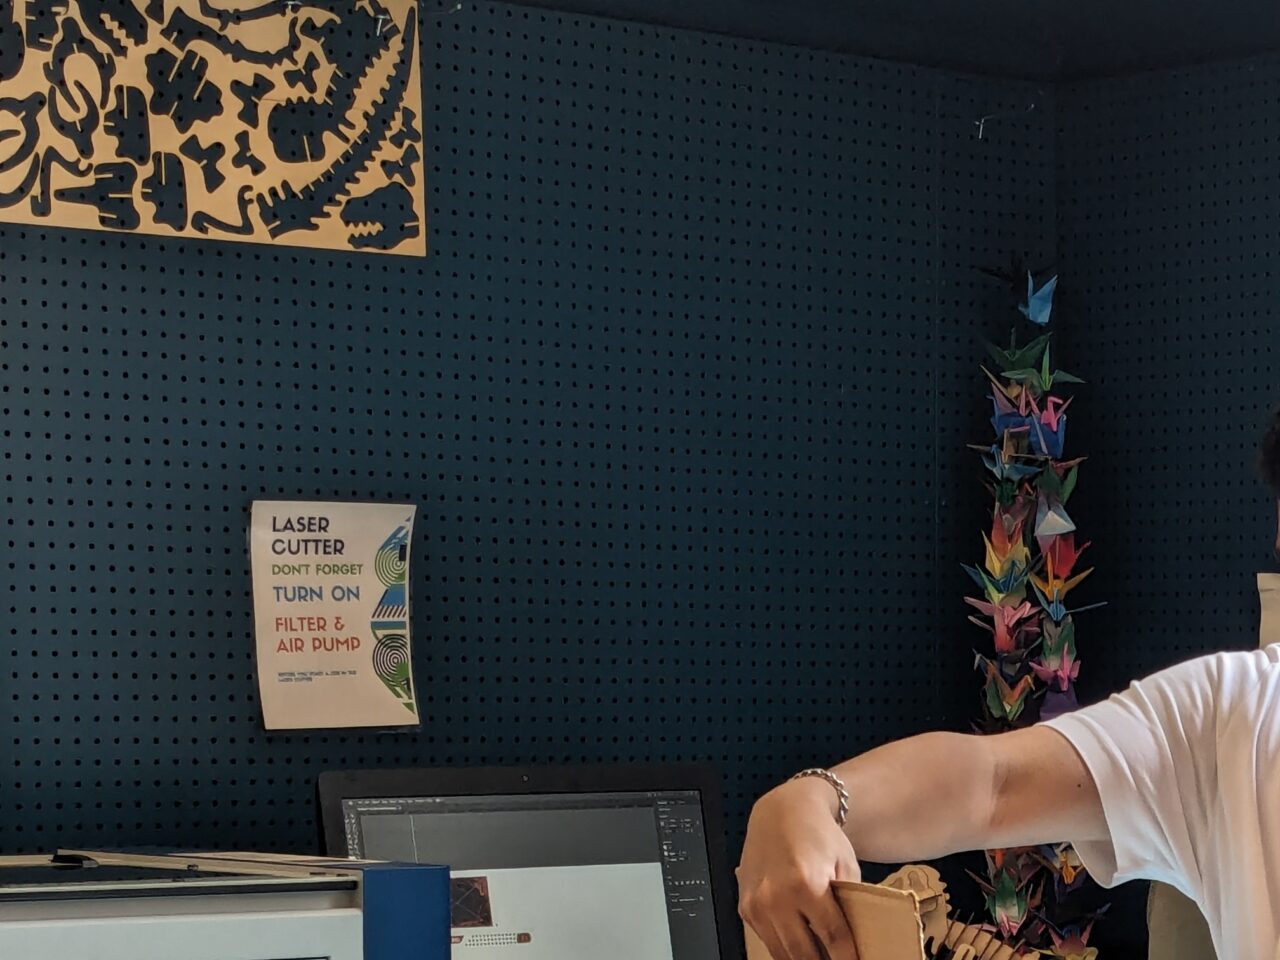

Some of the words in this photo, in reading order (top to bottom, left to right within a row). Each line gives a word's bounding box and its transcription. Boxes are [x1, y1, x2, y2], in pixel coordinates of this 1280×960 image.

[272, 516, 330, 533] LASER
[271, 539, 345, 556] CUTTER
[271, 564, 311, 575] DON'T
[315, 564, 364, 575] FORGET
[273, 586, 323, 602] TURN
[331, 586, 360, 601] ON
[275, 617, 327, 632] FILTER
[334, 617, 345, 631] &
[276, 637, 304, 653] AIR
[312, 637, 361, 652] PUMP
